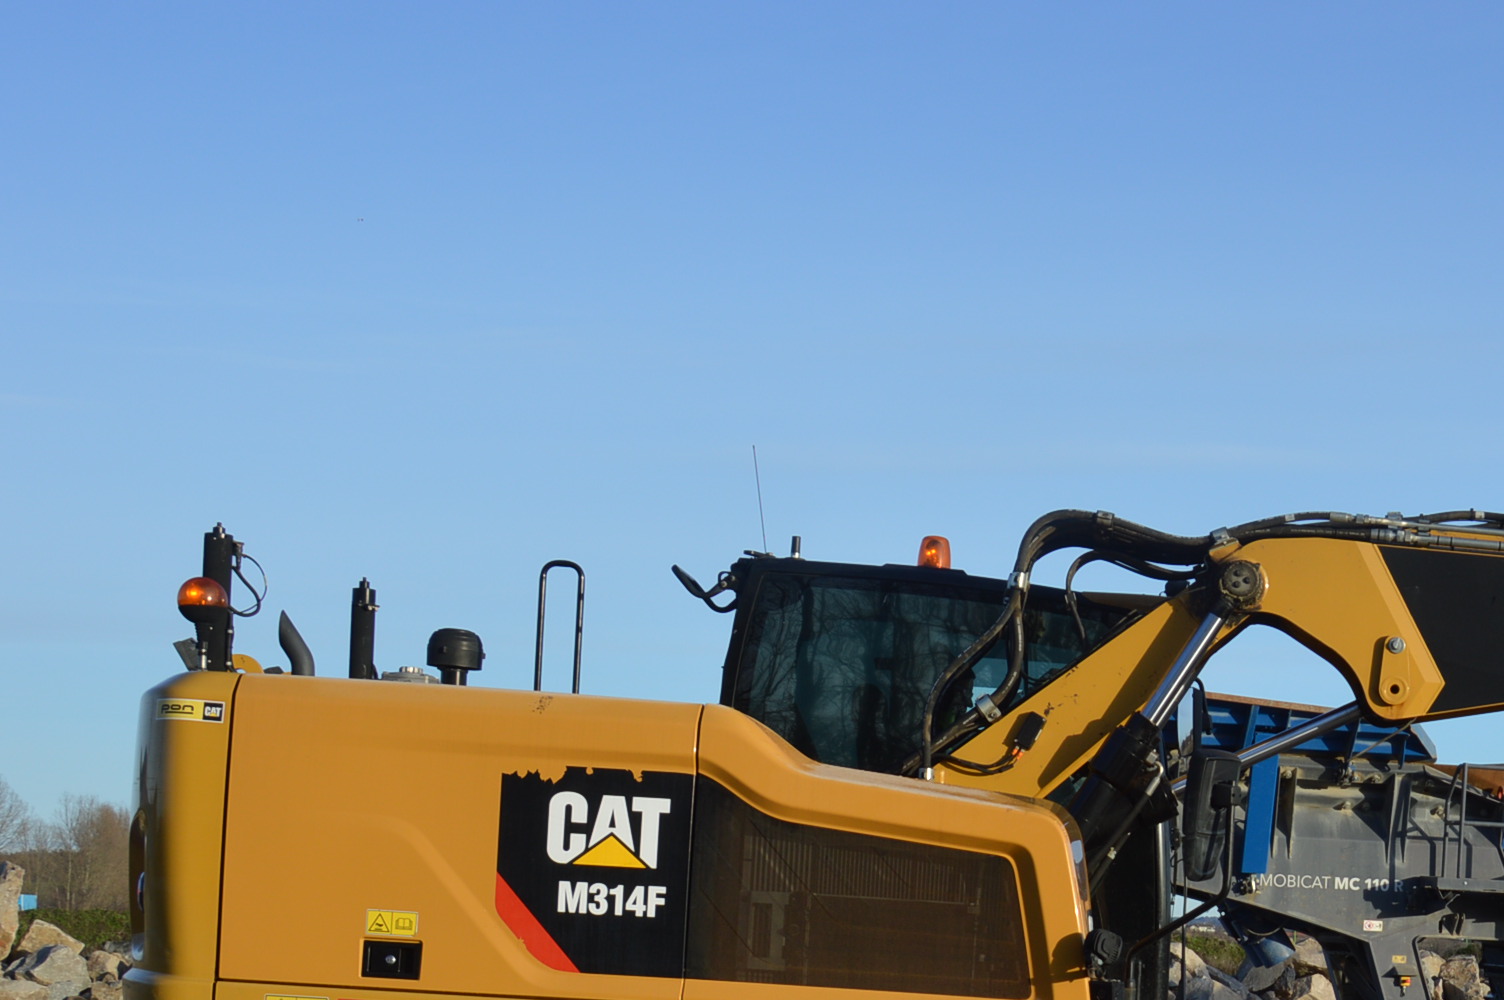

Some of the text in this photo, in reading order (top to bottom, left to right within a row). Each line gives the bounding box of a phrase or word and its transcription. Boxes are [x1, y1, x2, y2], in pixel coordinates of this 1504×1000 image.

[204, 706, 222, 717] CAT
[546, 791, 671, 869] CAT
[1259, 873, 1404, 893] MOBICAT MC 110 R
[557, 880, 667, 918] M314F
